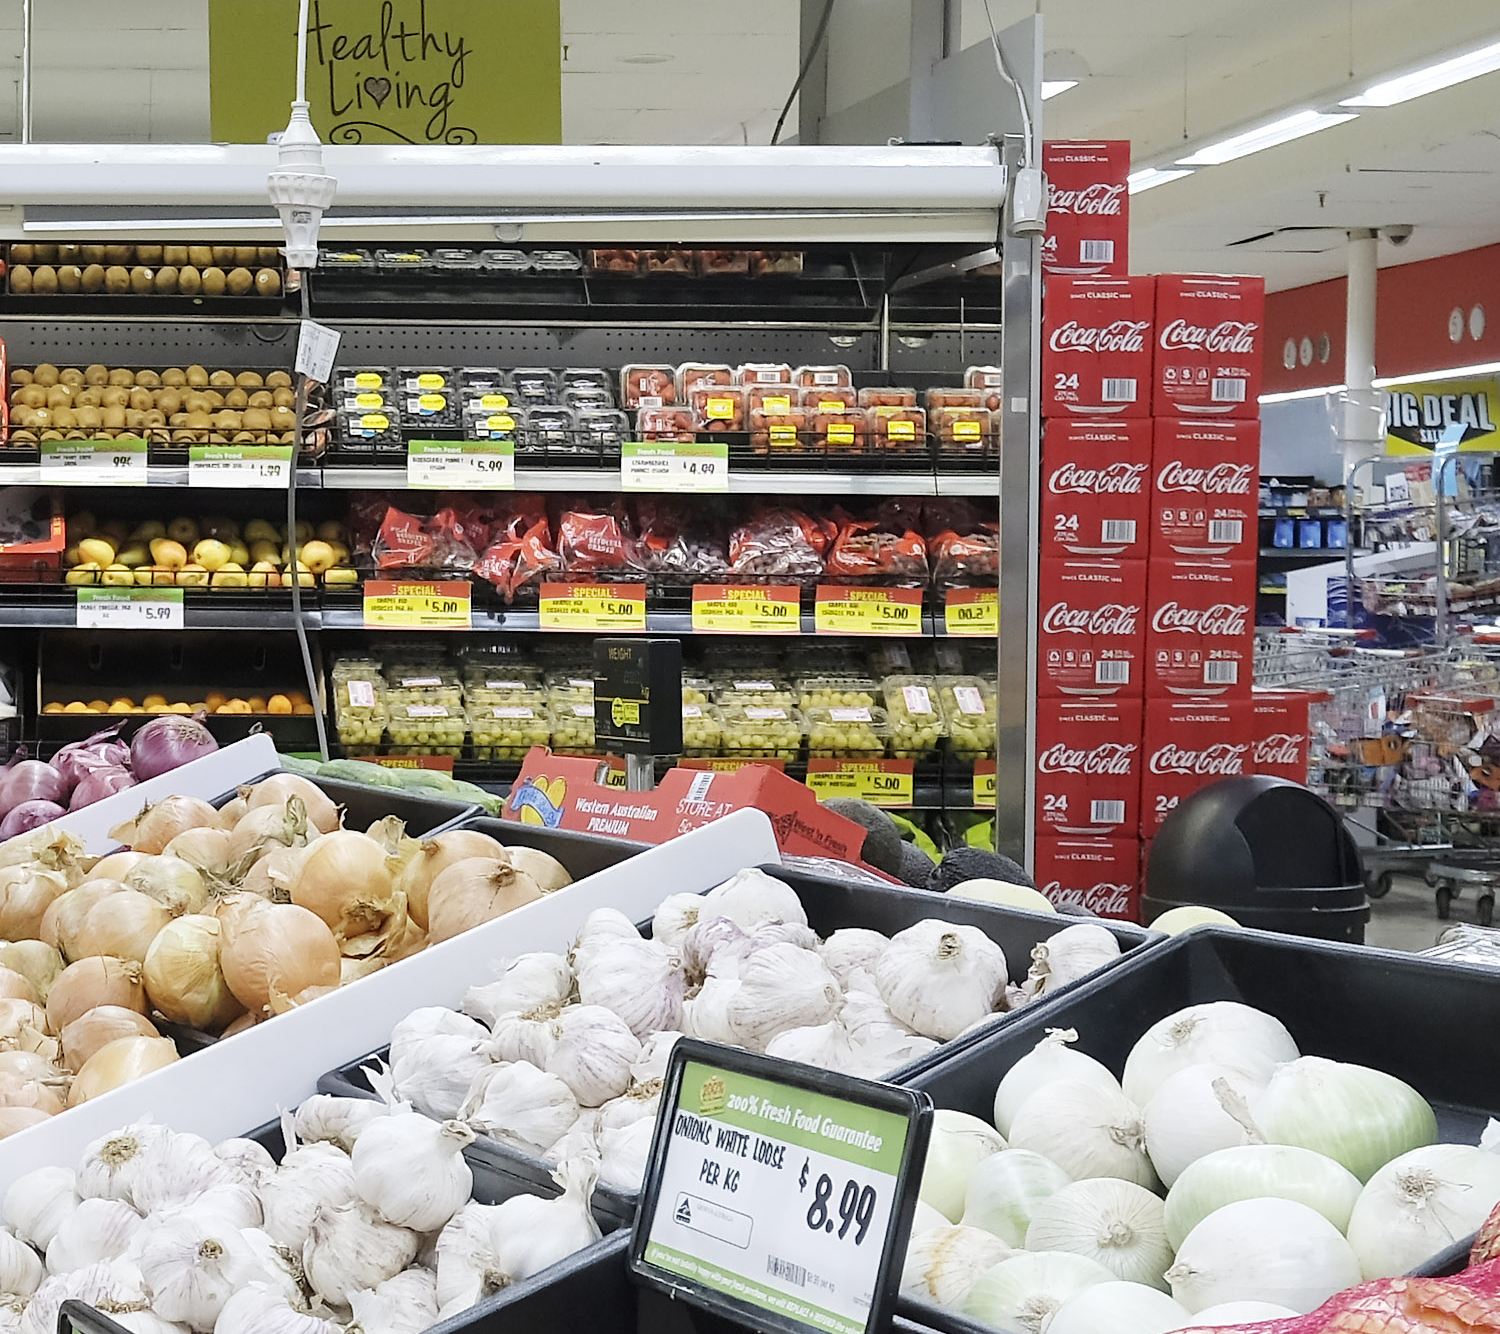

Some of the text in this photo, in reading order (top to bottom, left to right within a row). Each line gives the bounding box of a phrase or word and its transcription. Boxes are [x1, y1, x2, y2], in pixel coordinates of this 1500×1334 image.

[1054, 373, 1080, 390] 24
[1422, 392, 1497, 432] DEAL
[1054, 514, 1080, 531] 24
[397, 585, 437, 596] SPECIAL
[572, 586, 613, 598] SPECIAL
[727, 589, 767, 600] SPECIAL
[849, 590, 888, 602] SPECIAL
[424, 598, 458, 614] $5.00
[600, 600, 634, 616] $5.00
[754, 602, 788, 618] $5.00
[876, 604, 909, 620] $5.00
[608, 647, 632, 661] WEIGHT
[841, 762, 880, 773] SPECIAL
[866, 775, 901, 790] $5.00
[575, 797, 658, 823] Western Australian
[676, 798, 734, 817] STORE AT
[1043, 794, 1068, 811] 24
[587, 816, 629, 837] PREMIUM
[726, 1093, 883, 1154] 200% Fresh Food Guarantee
[675, 1114, 787, 1171] ONIONS WHITE LOOSE
[699, 1158, 741, 1194] PER KG
